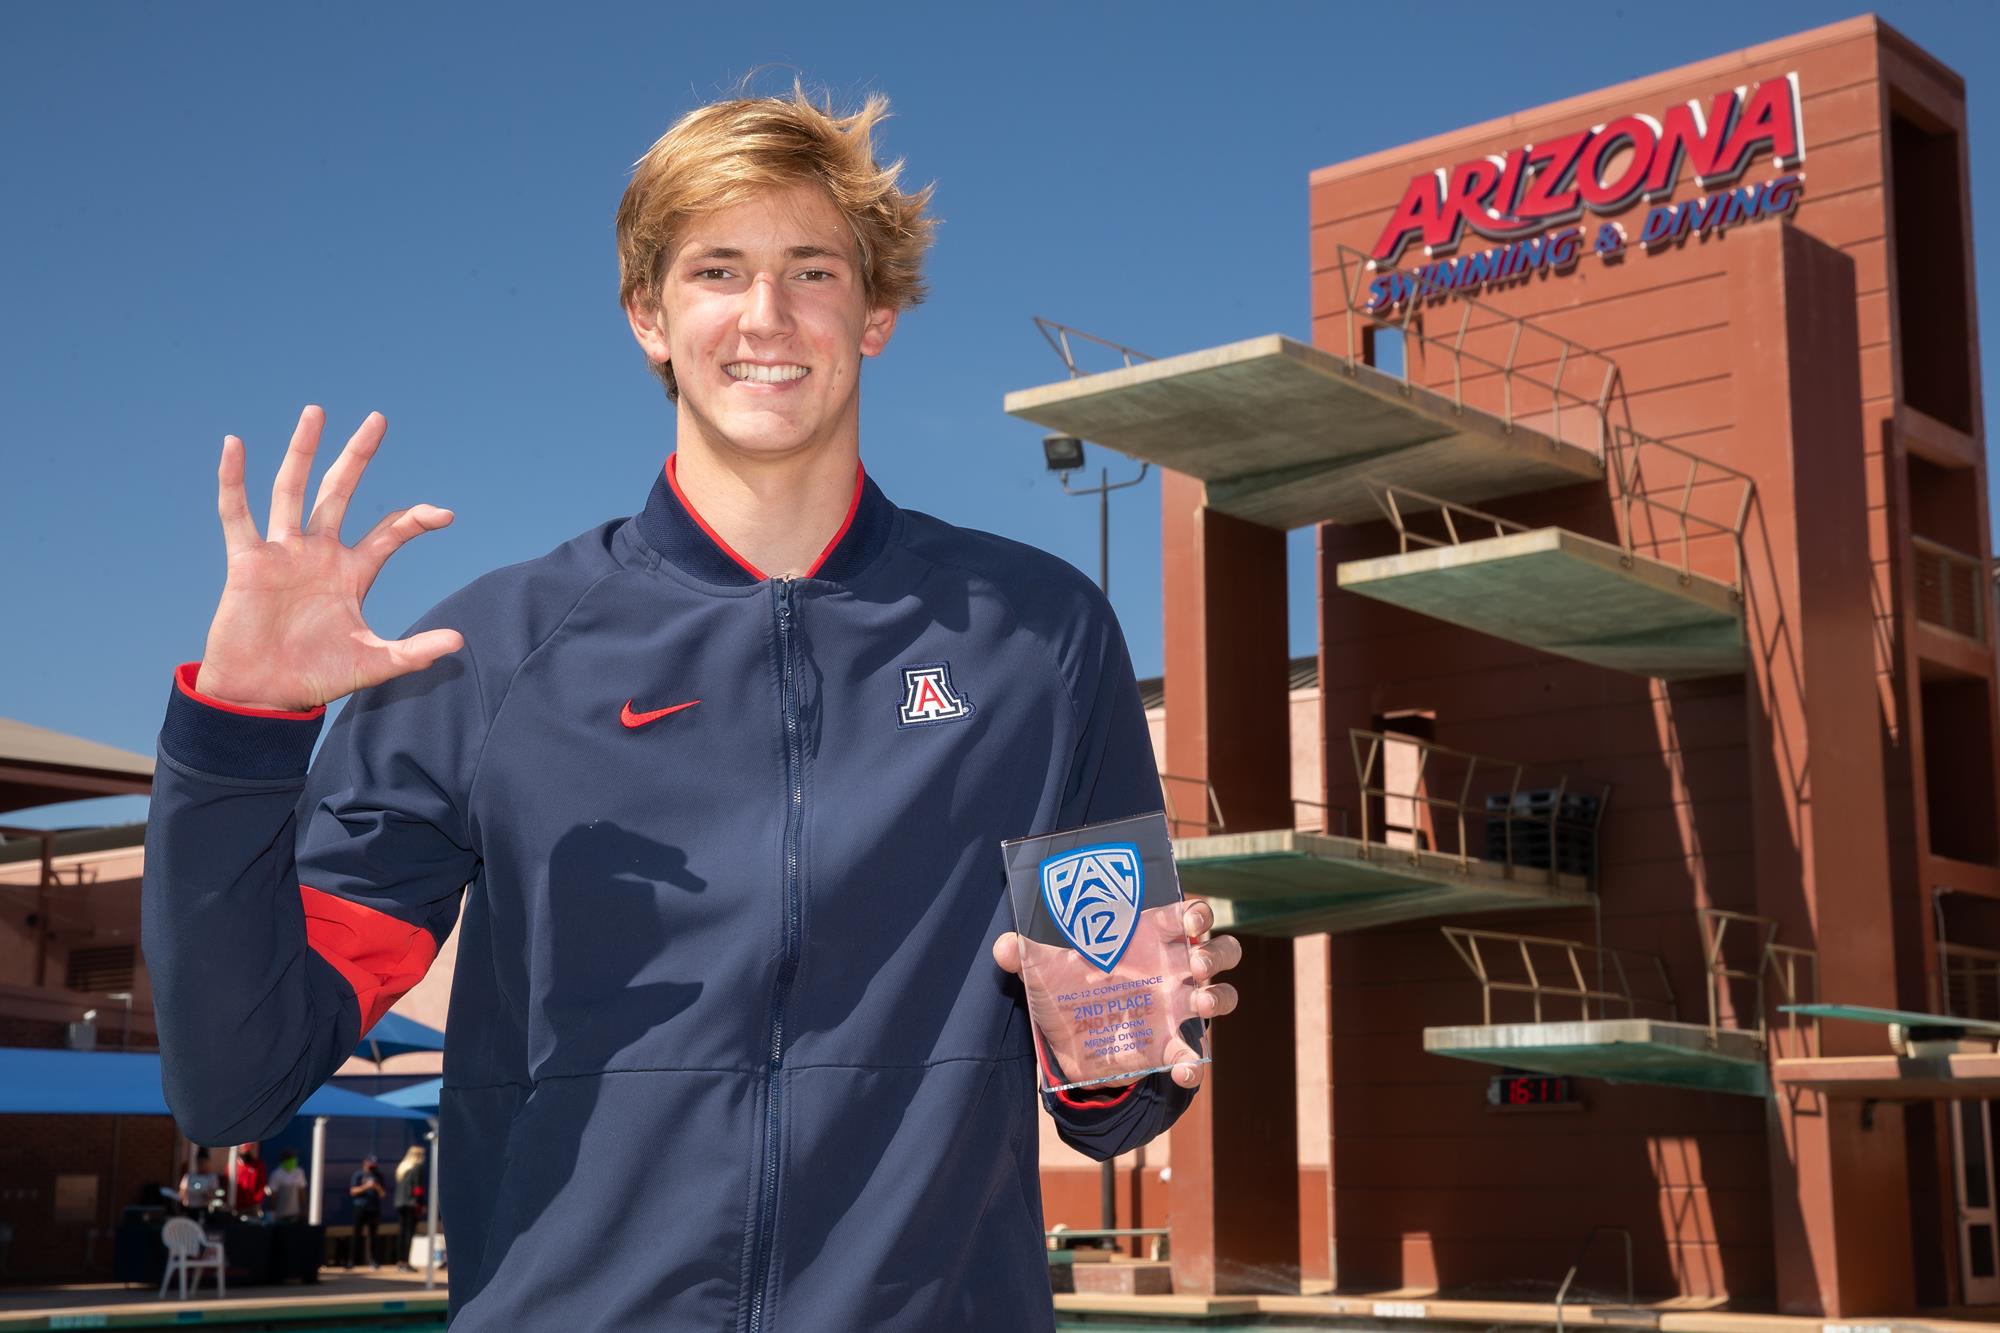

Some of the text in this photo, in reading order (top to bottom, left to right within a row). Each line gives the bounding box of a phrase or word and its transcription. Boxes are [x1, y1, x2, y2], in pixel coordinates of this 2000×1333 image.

[1366, 71, 1805, 269] ARIZONA
[1366, 174, 1806, 313] SWIMMING & DIVING
[902, 667, 963, 723] A
[1050, 853, 1134, 924] PAC
[1081, 910, 1119, 946] 12
[1057, 975, 1164, 1003] PAC-12 CONFERENCE
[1074, 993, 1153, 1020] 2ND PLACE
[1088, 1019, 1145, 1036] PLATFORM
[1118, 1028, 1153, 1042] DIVING
